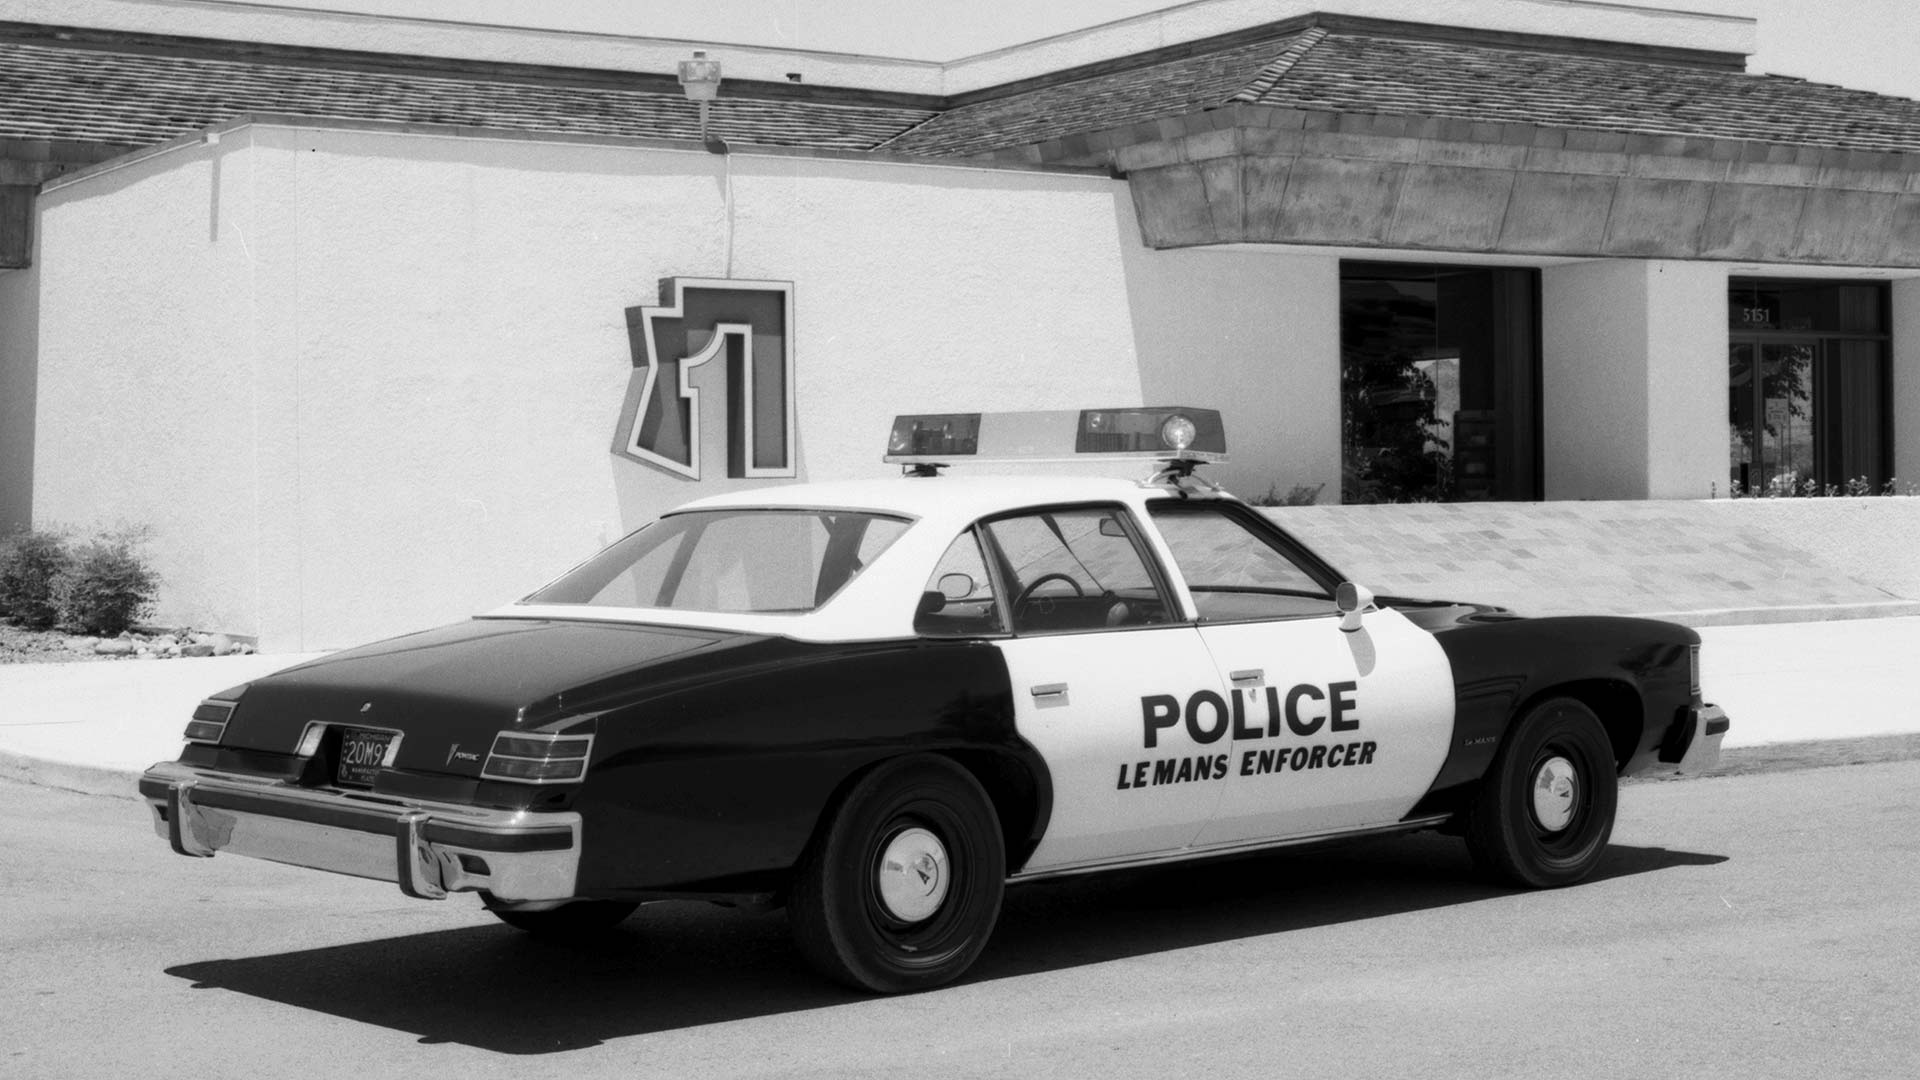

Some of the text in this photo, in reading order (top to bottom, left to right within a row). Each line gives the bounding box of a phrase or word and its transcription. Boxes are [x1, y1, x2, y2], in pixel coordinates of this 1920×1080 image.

[1141, 681, 1359, 748] POLICE
[1117, 741, 1377, 790] LEMANS ENFORCER
